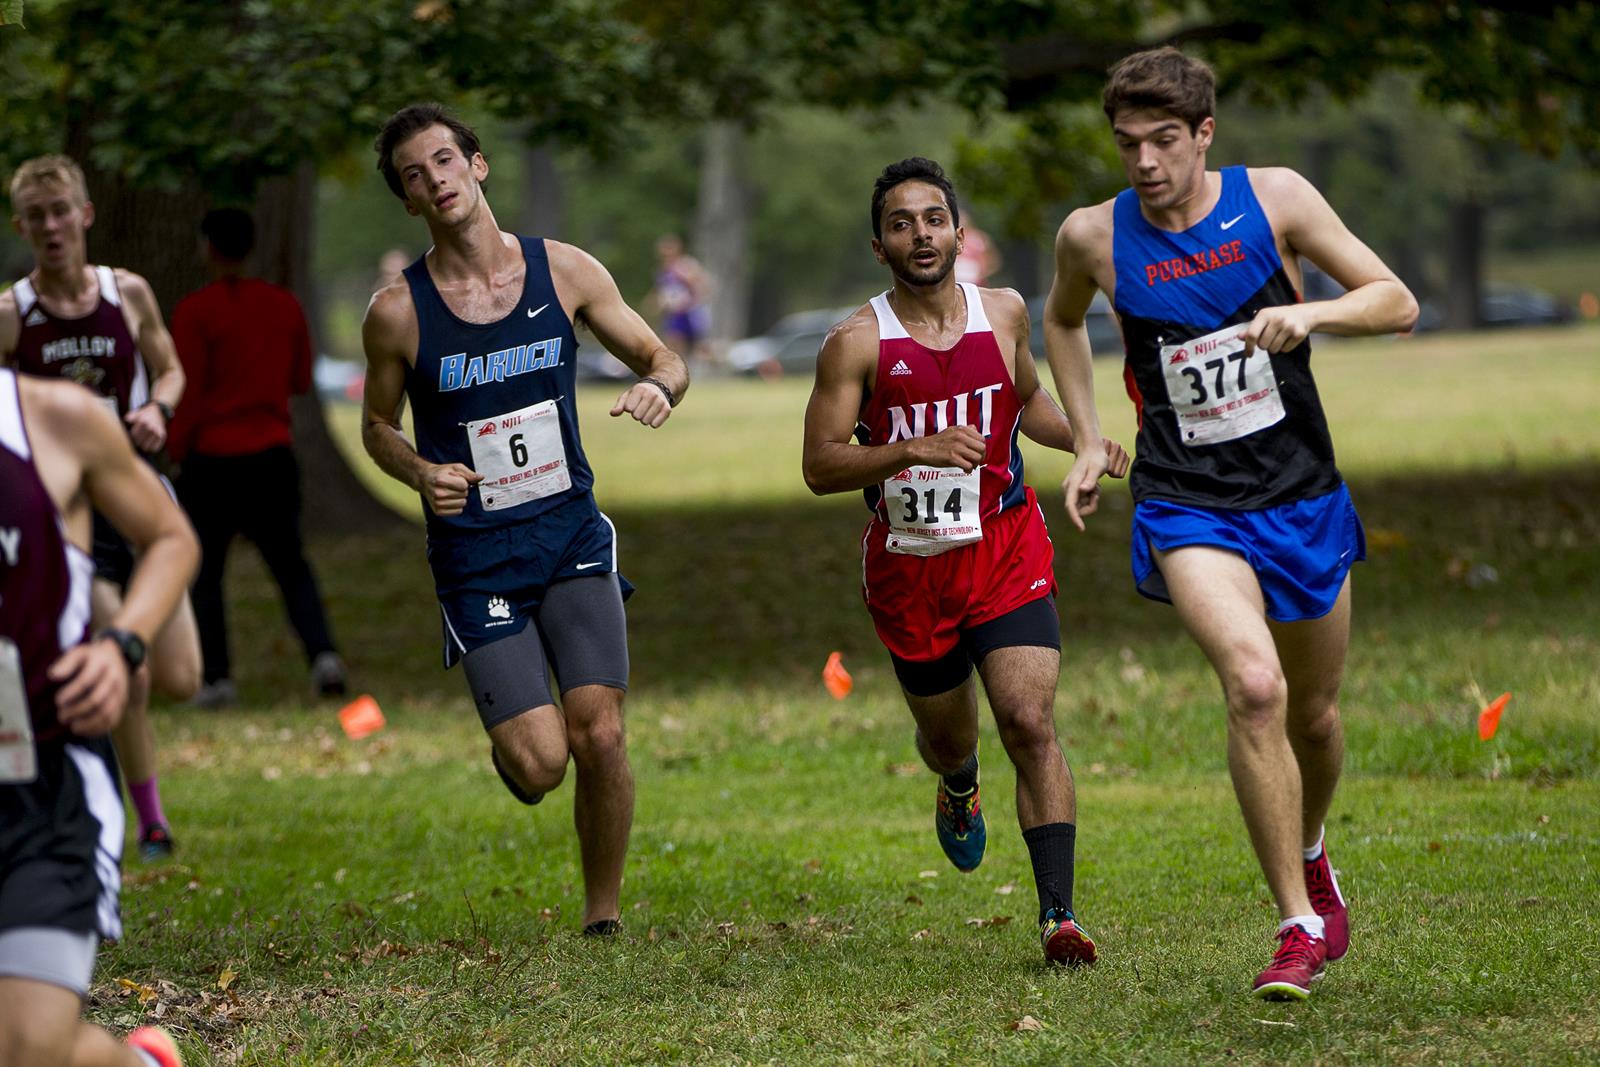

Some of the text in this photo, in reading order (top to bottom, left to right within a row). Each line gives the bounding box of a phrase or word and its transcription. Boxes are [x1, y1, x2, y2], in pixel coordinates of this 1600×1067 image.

[1145, 240, 1246, 286] PURCHASE
[42, 336, 116, 364] MOLLOY
[1195, 339, 1217, 355] NJIT
[1181, 350, 1247, 405] 377
[502, 416, 522, 429] NJIT
[509, 433, 528, 467] 6
[918, 471, 941, 482] NJIT
[901, 487, 962, 523] 314
[917, 527, 930, 536] JERSEY
[949, 525, 973, 535] TECHNOLOGY
